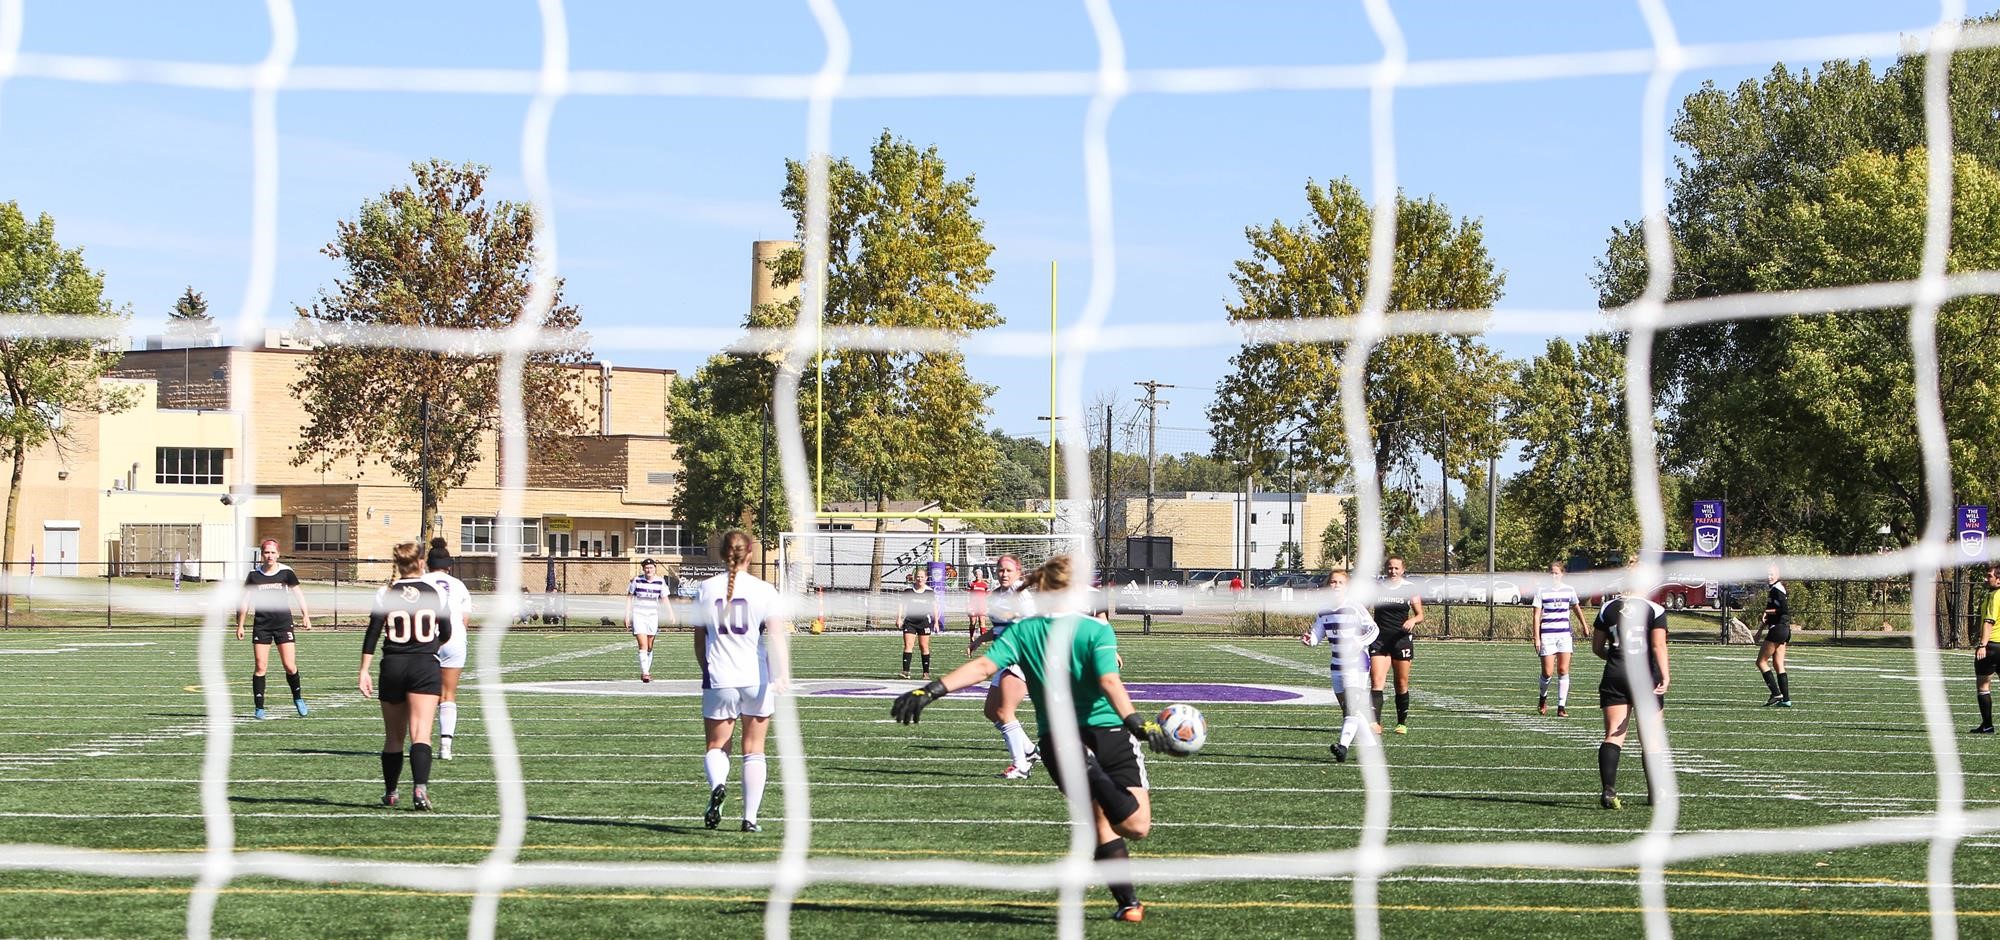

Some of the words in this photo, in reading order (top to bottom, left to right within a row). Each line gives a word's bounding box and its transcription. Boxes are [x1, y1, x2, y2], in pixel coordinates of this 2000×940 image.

[387, 608, 437, 644] 00
[714, 598, 749, 635] 10
[287, 632, 294, 640] 3
[1608, 624, 1646, 655] 15
[1401, 648, 1412, 658] 12
